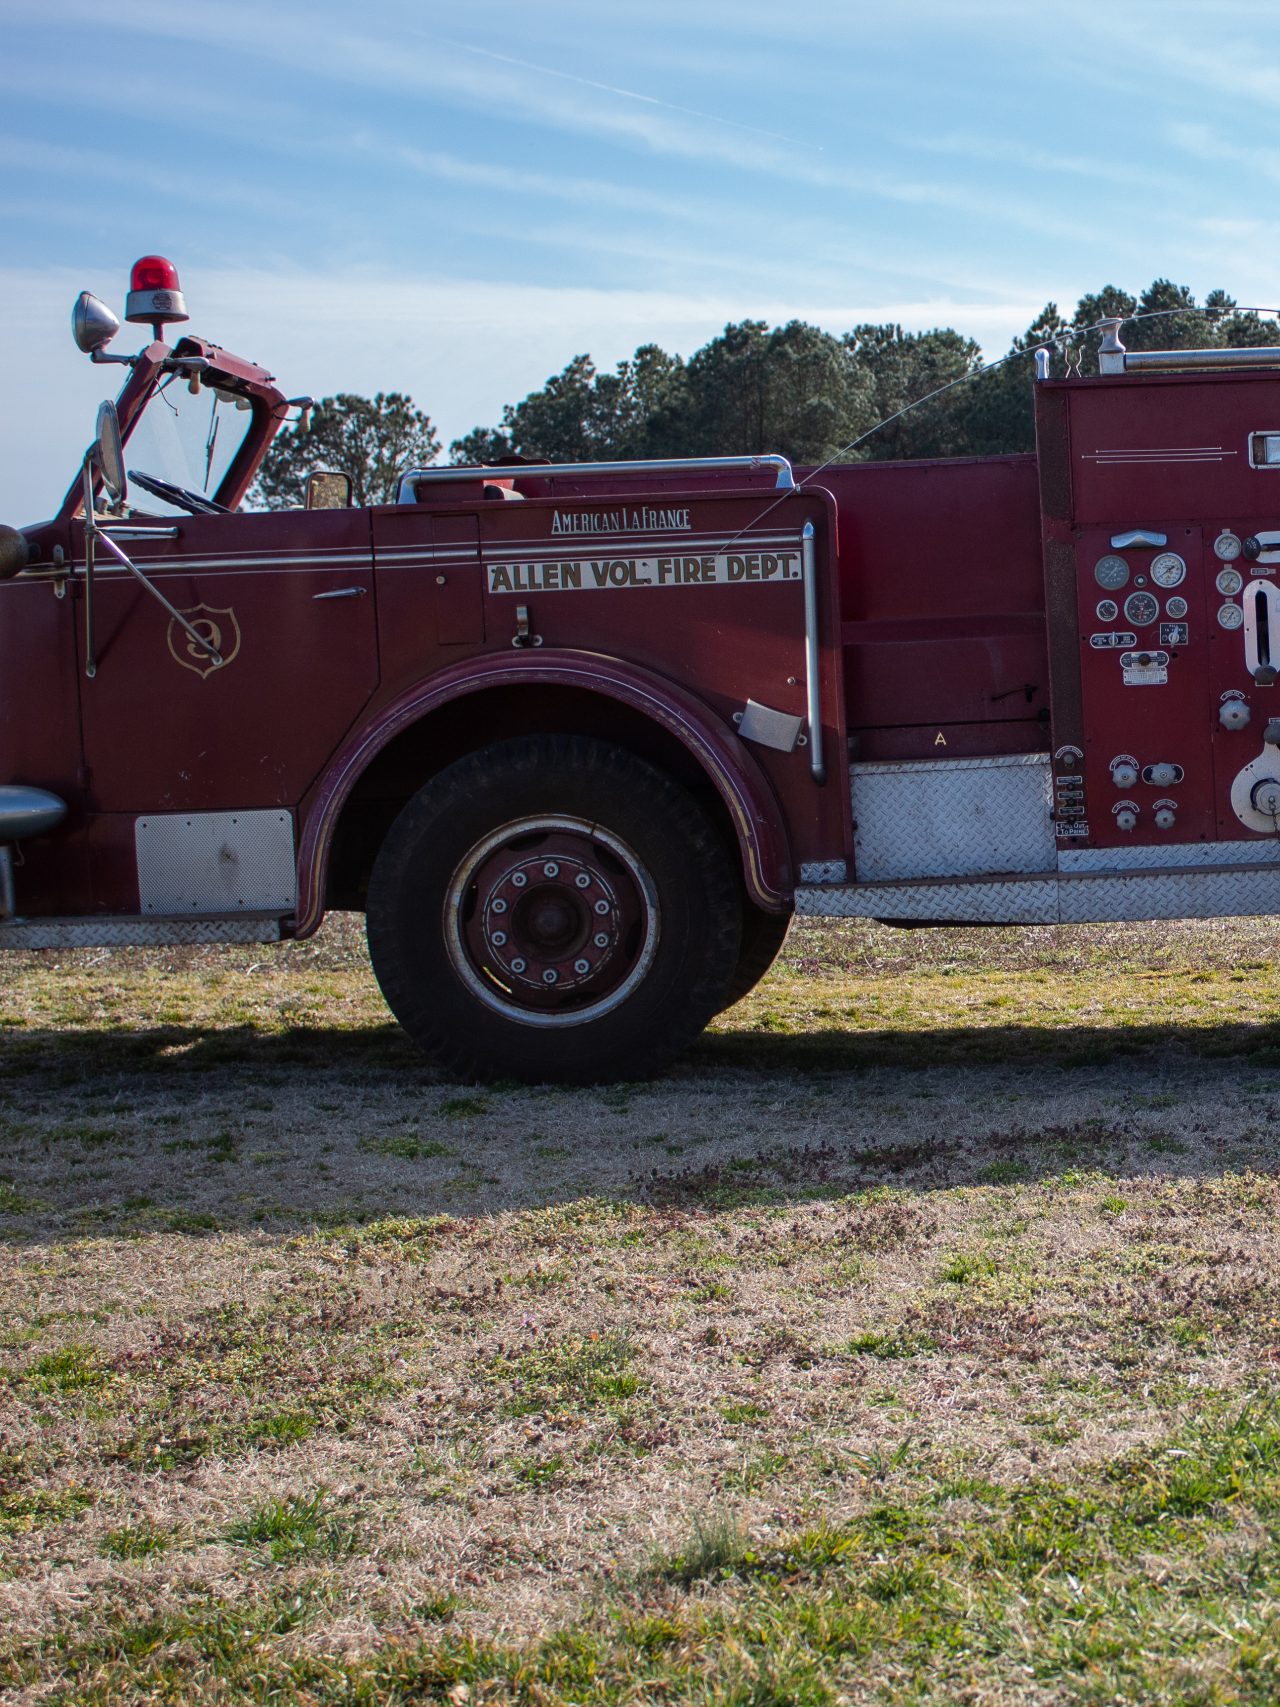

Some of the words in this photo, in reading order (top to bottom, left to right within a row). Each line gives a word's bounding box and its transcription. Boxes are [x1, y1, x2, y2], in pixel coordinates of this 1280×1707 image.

[551, 509, 620, 533] AMERICAN
[491, 563, 582, 591] ALLEN
[657, 556, 717, 584] FIRE
[727, 553, 799, 581] DEPT.
[185, 619, 222, 660] 9
[934, 730, 947, 746] A
